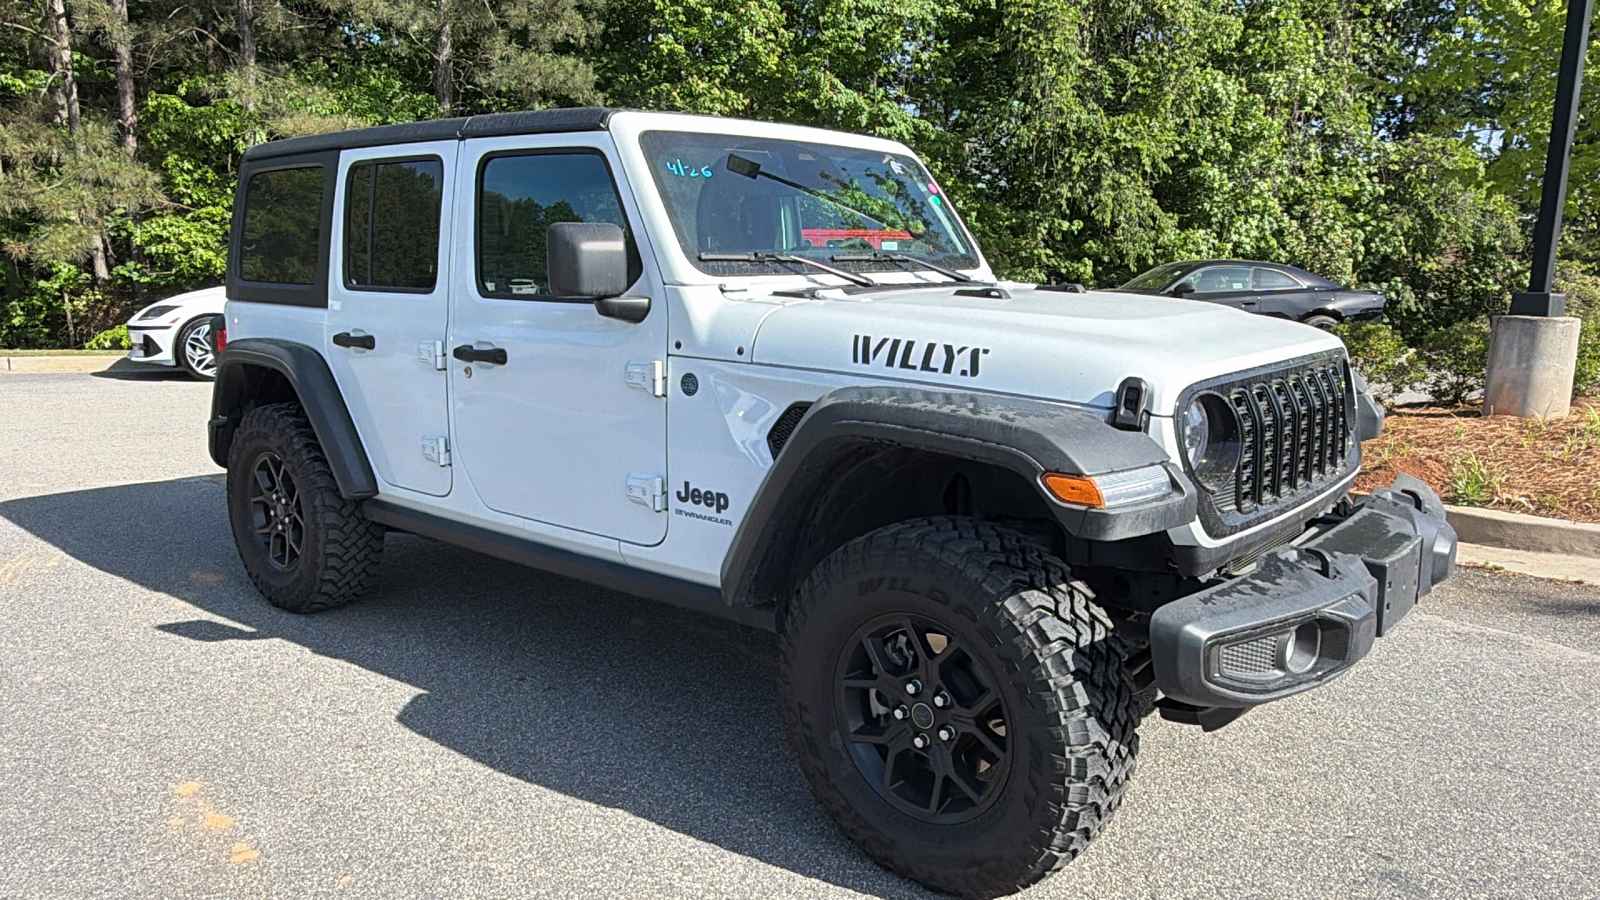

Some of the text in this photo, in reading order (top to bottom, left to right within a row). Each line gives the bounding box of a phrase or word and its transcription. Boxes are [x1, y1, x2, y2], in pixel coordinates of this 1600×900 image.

[852, 334, 990, 378] WILLYS
[676, 481, 729, 514] Jeep
[683, 510, 732, 526] WRANGLER
